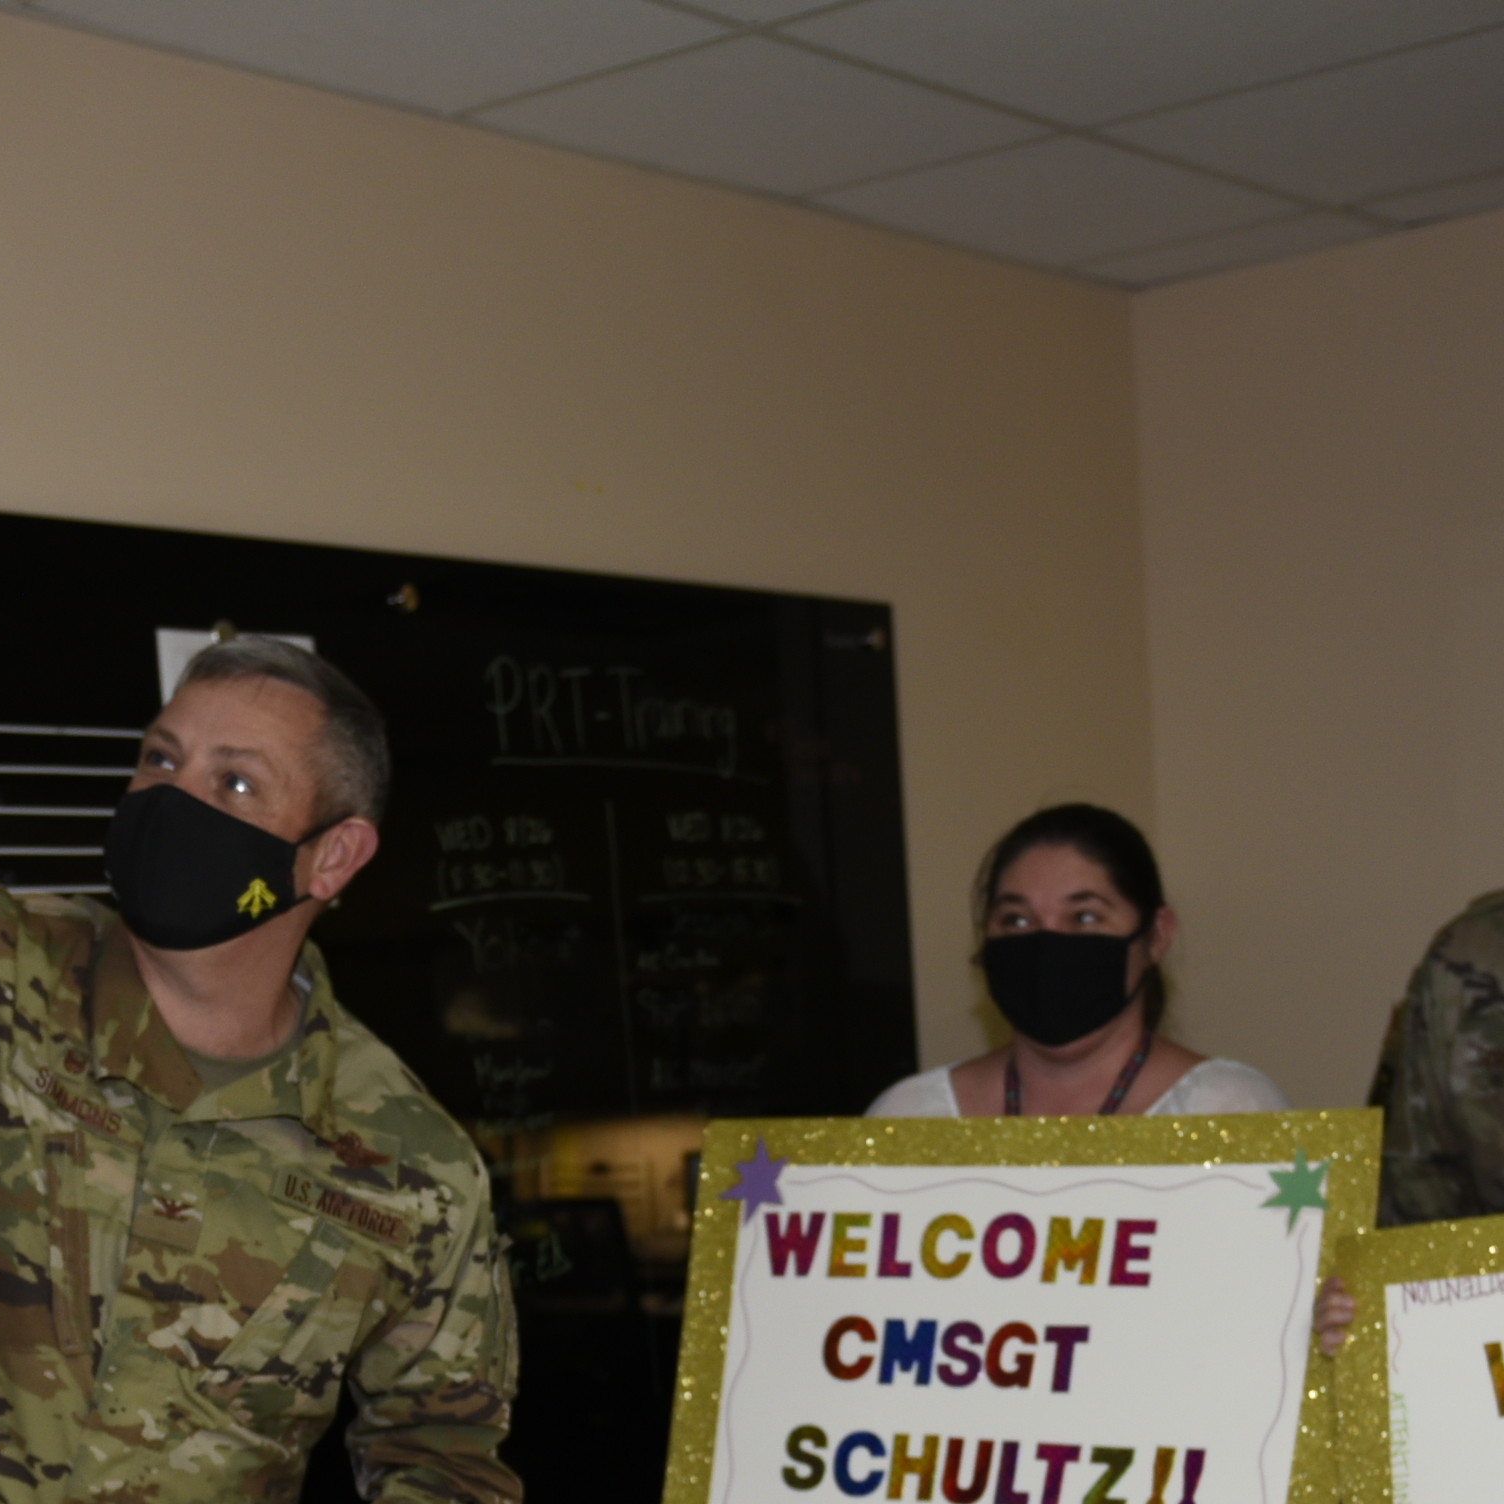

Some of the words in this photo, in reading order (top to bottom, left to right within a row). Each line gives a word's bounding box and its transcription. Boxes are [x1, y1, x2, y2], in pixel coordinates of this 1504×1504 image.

[36, 1066, 123, 1135] SIMMONS
[284, 1174, 313, 1206] U.S.
[316, 1188, 347, 1219] AIR
[348, 1201, 404, 1239] FORCE
[764, 1212, 1158, 1287] WELCOME
[822, 1315, 1090, 1393] CMSGT
